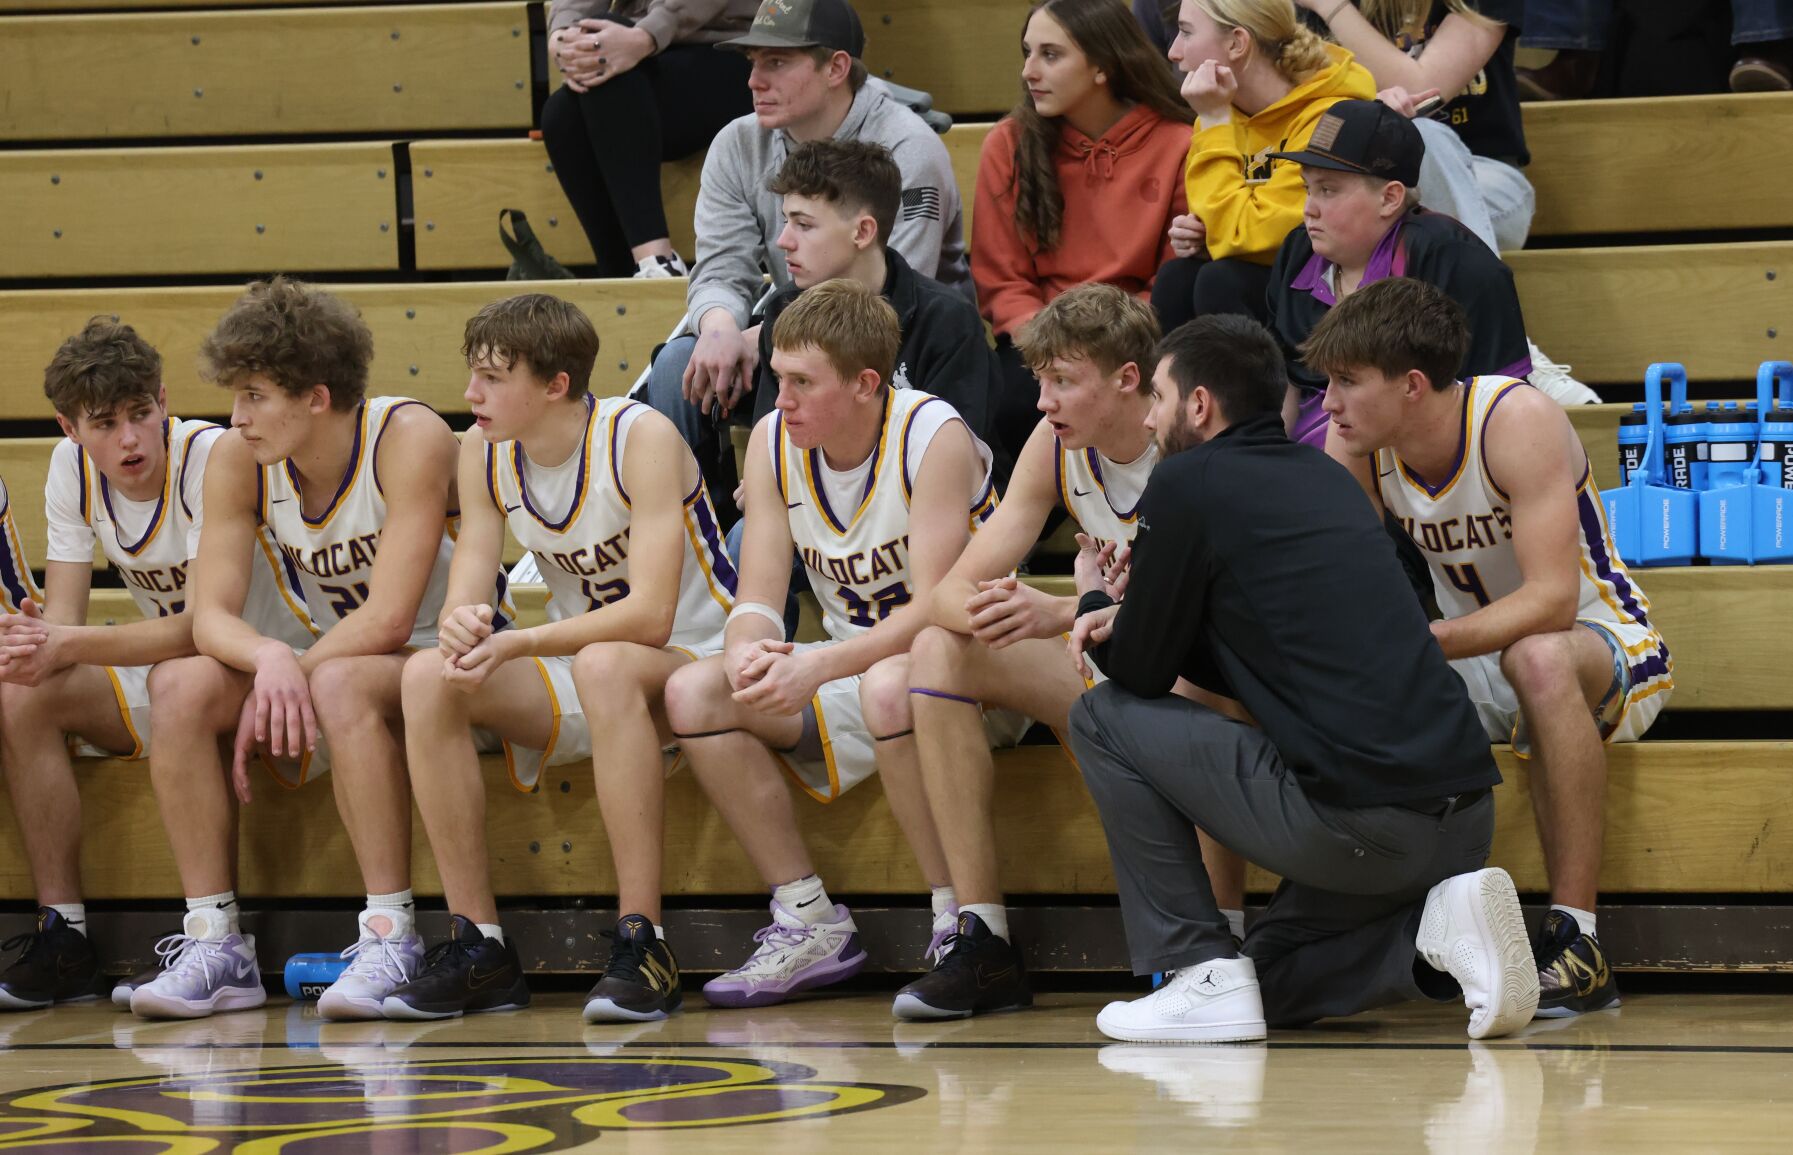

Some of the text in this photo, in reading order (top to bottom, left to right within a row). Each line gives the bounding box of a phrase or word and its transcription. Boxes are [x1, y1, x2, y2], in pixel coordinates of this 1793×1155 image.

[1452, 107, 1469, 125] 61
[1662, 499, 1671, 550] POWERADE
[1719, 499, 1728, 551] POWERADE
[1775, 497, 1784, 549] POWERADE
[1441, 562, 1492, 608] 4
